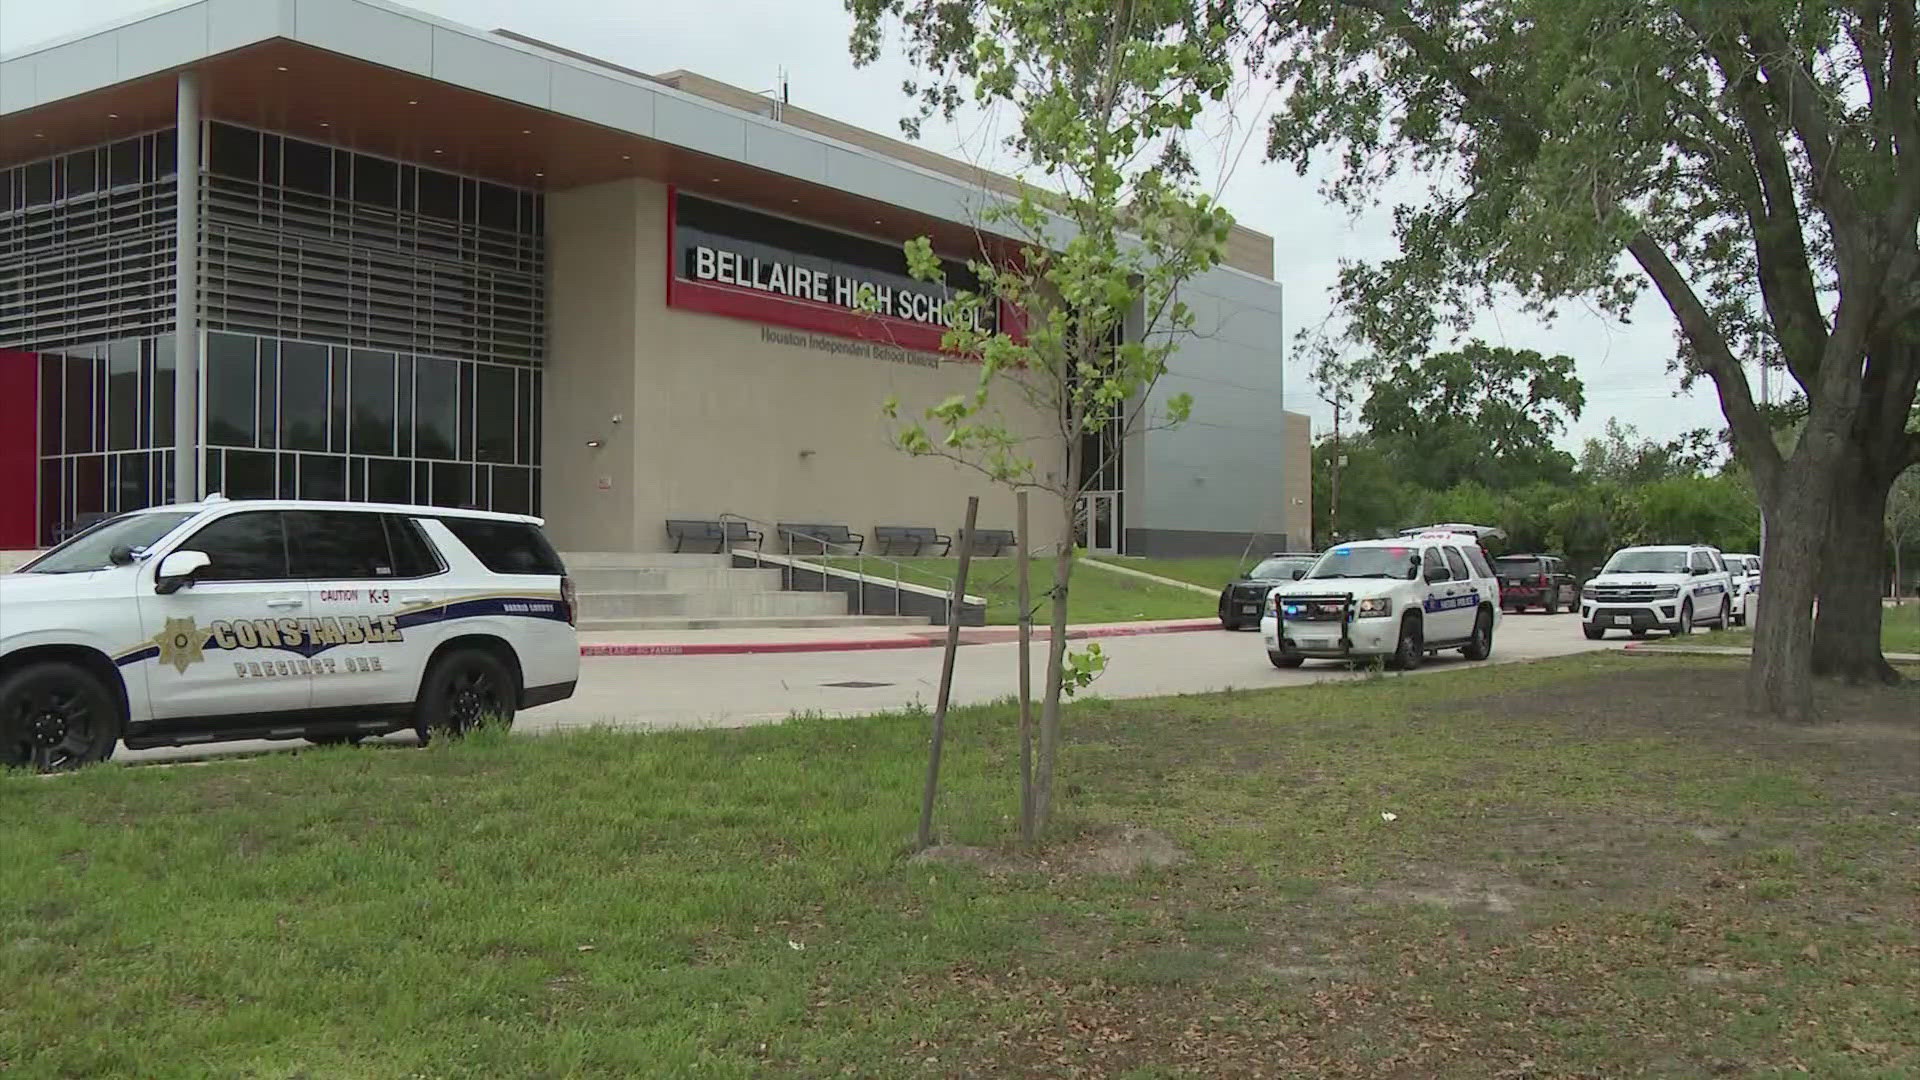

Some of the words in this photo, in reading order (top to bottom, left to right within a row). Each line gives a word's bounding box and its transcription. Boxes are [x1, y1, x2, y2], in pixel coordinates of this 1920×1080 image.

[697, 246, 829, 302] BELLAIRE
[835, 276, 892, 316] HIGH
[761, 326, 807, 348] Houston
[809, 335, 870, 360] Independent
[873, 346, 905, 364] School
[907, 350, 939, 370] District
[320, 589, 358, 602] CAUTION
[369, 588, 390, 603] K-9
[211, 615, 404, 650] CONSTABLE
[234, 658, 336, 678] PRECINCT
[345, 656, 383, 673] ONE
